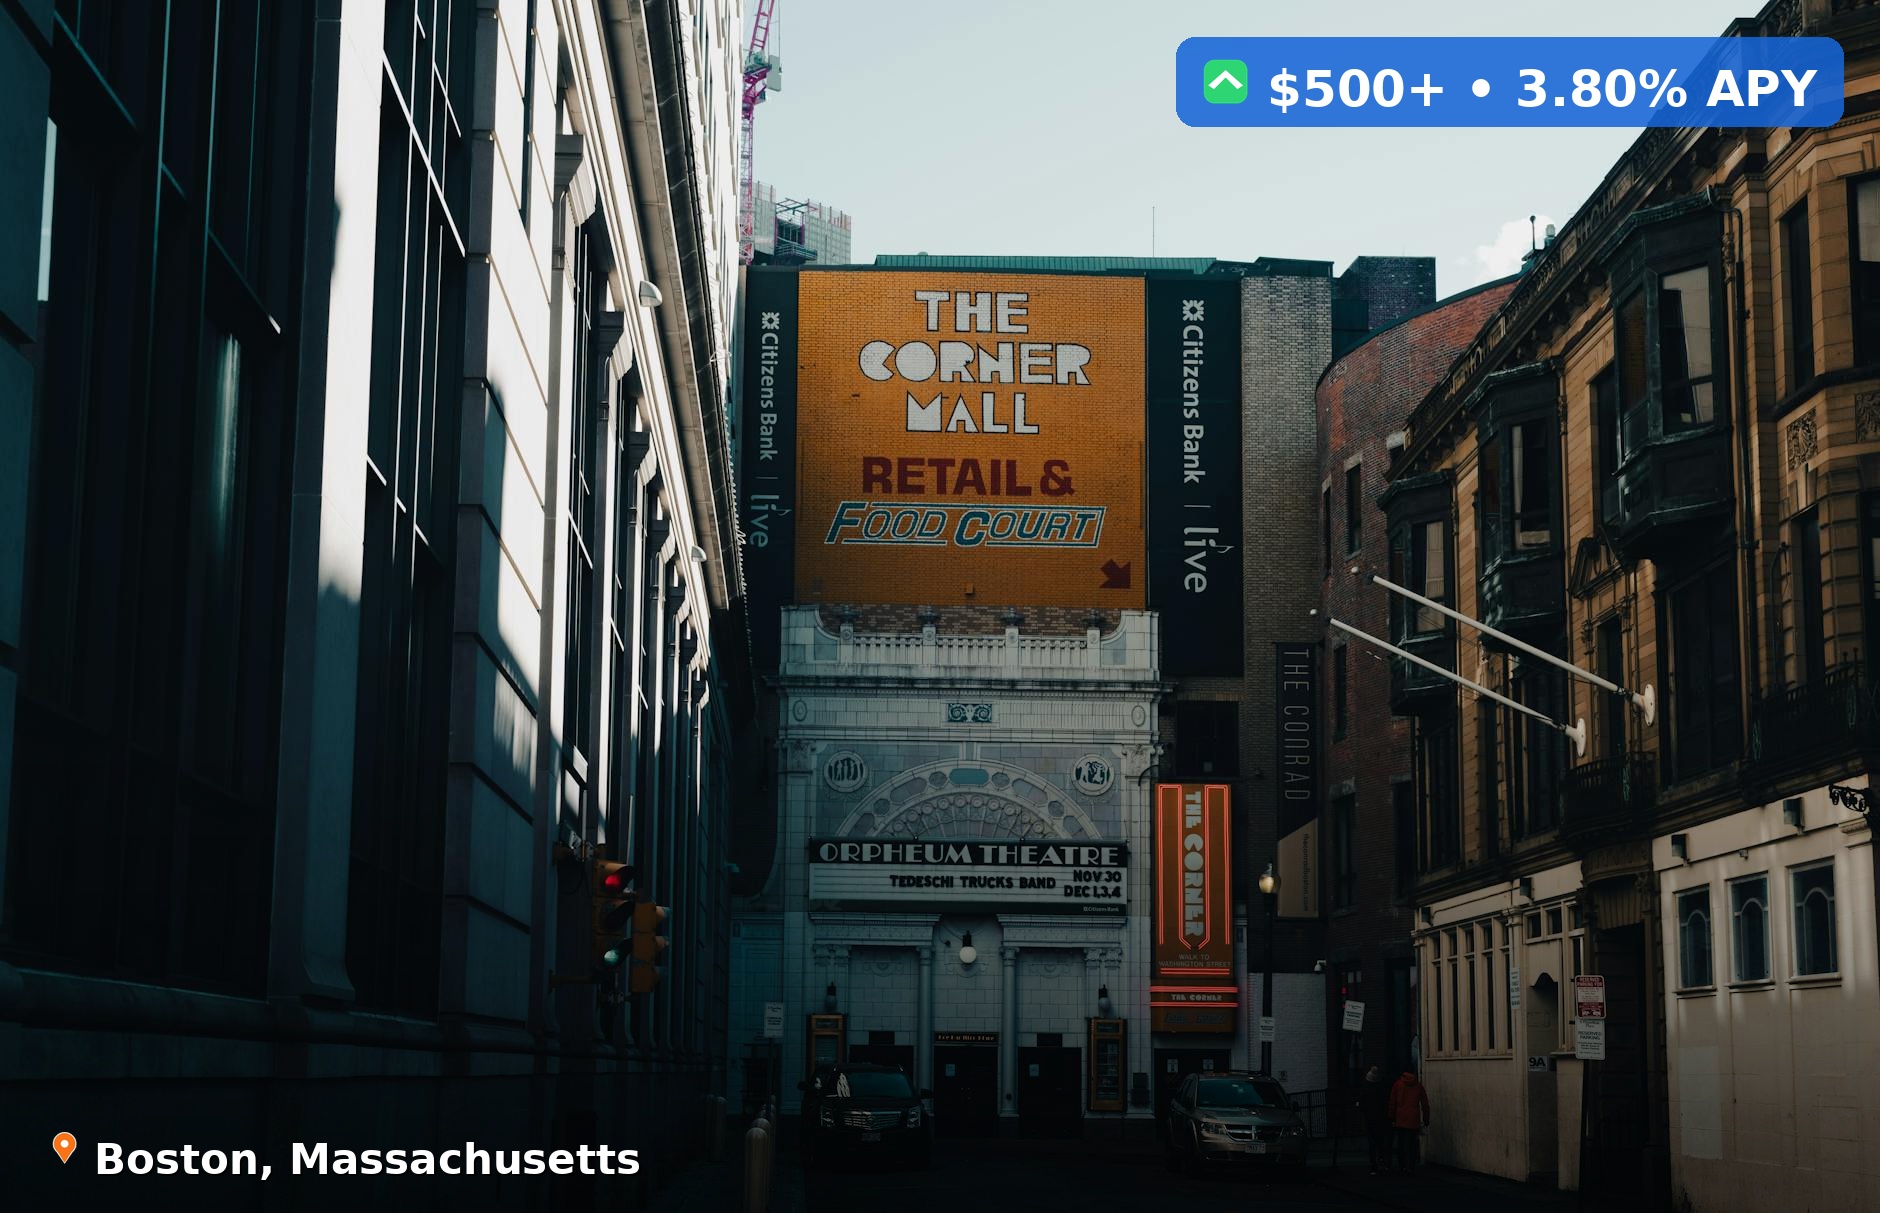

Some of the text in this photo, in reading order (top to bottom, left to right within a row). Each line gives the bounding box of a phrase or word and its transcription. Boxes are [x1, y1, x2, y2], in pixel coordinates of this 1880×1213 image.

[915, 290, 1029, 334] THE
[858, 340, 1092, 386] CORNER
[906, 390, 1040, 435] MALL
[750, 332, 782, 548] Citizens Bank live
[1182, 324, 1221, 593] Citizens Bank live
[862, 456, 1076, 496] RETAIL &
[1283, 648, 1311, 800] THE CONRAD
[818, 843, 1120, 867] ORPHEUM THEATRE
[1073, 870, 1122, 883] NOV 30
[1184, 791, 1204, 937] THE CORNER
[889, 875, 1056, 889] TEDESCHI TRUCKS BAND
[1064, 885, 1090, 898] DEC
[1529, 1057, 1546, 1067] 9A
